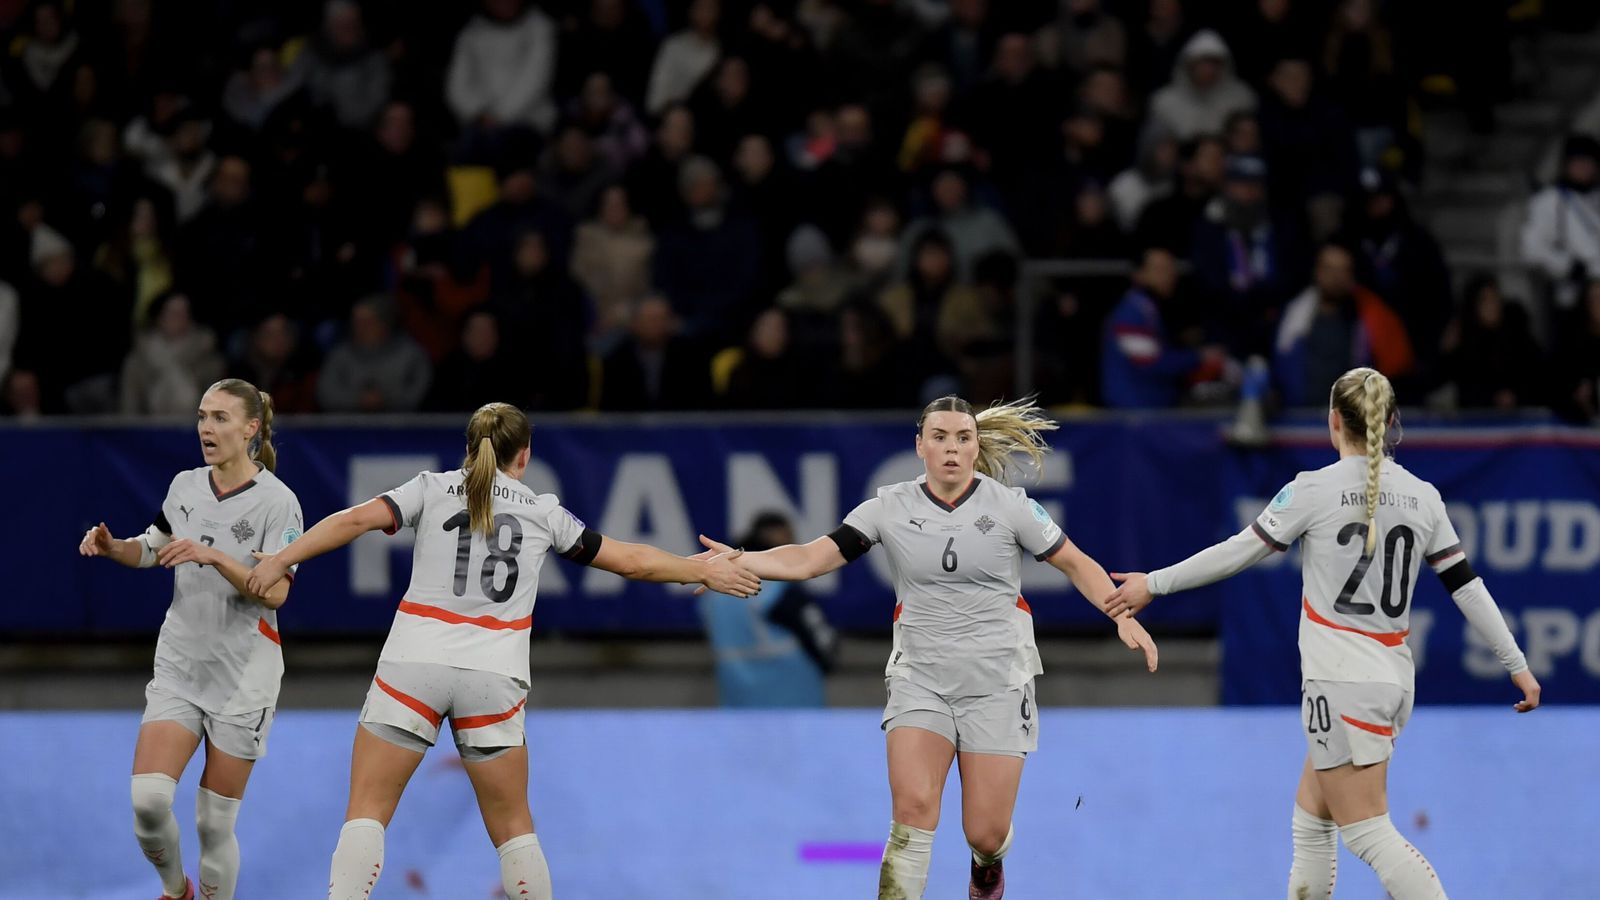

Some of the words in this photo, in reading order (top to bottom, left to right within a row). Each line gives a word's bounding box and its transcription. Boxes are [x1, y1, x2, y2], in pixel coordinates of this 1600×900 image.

[443, 509, 523, 603] 18
[942, 537, 958, 572] 6
[1333, 522, 1414, 618] 20
[1021, 683, 1031, 721] 6
[1307, 695, 1331, 733] 20
